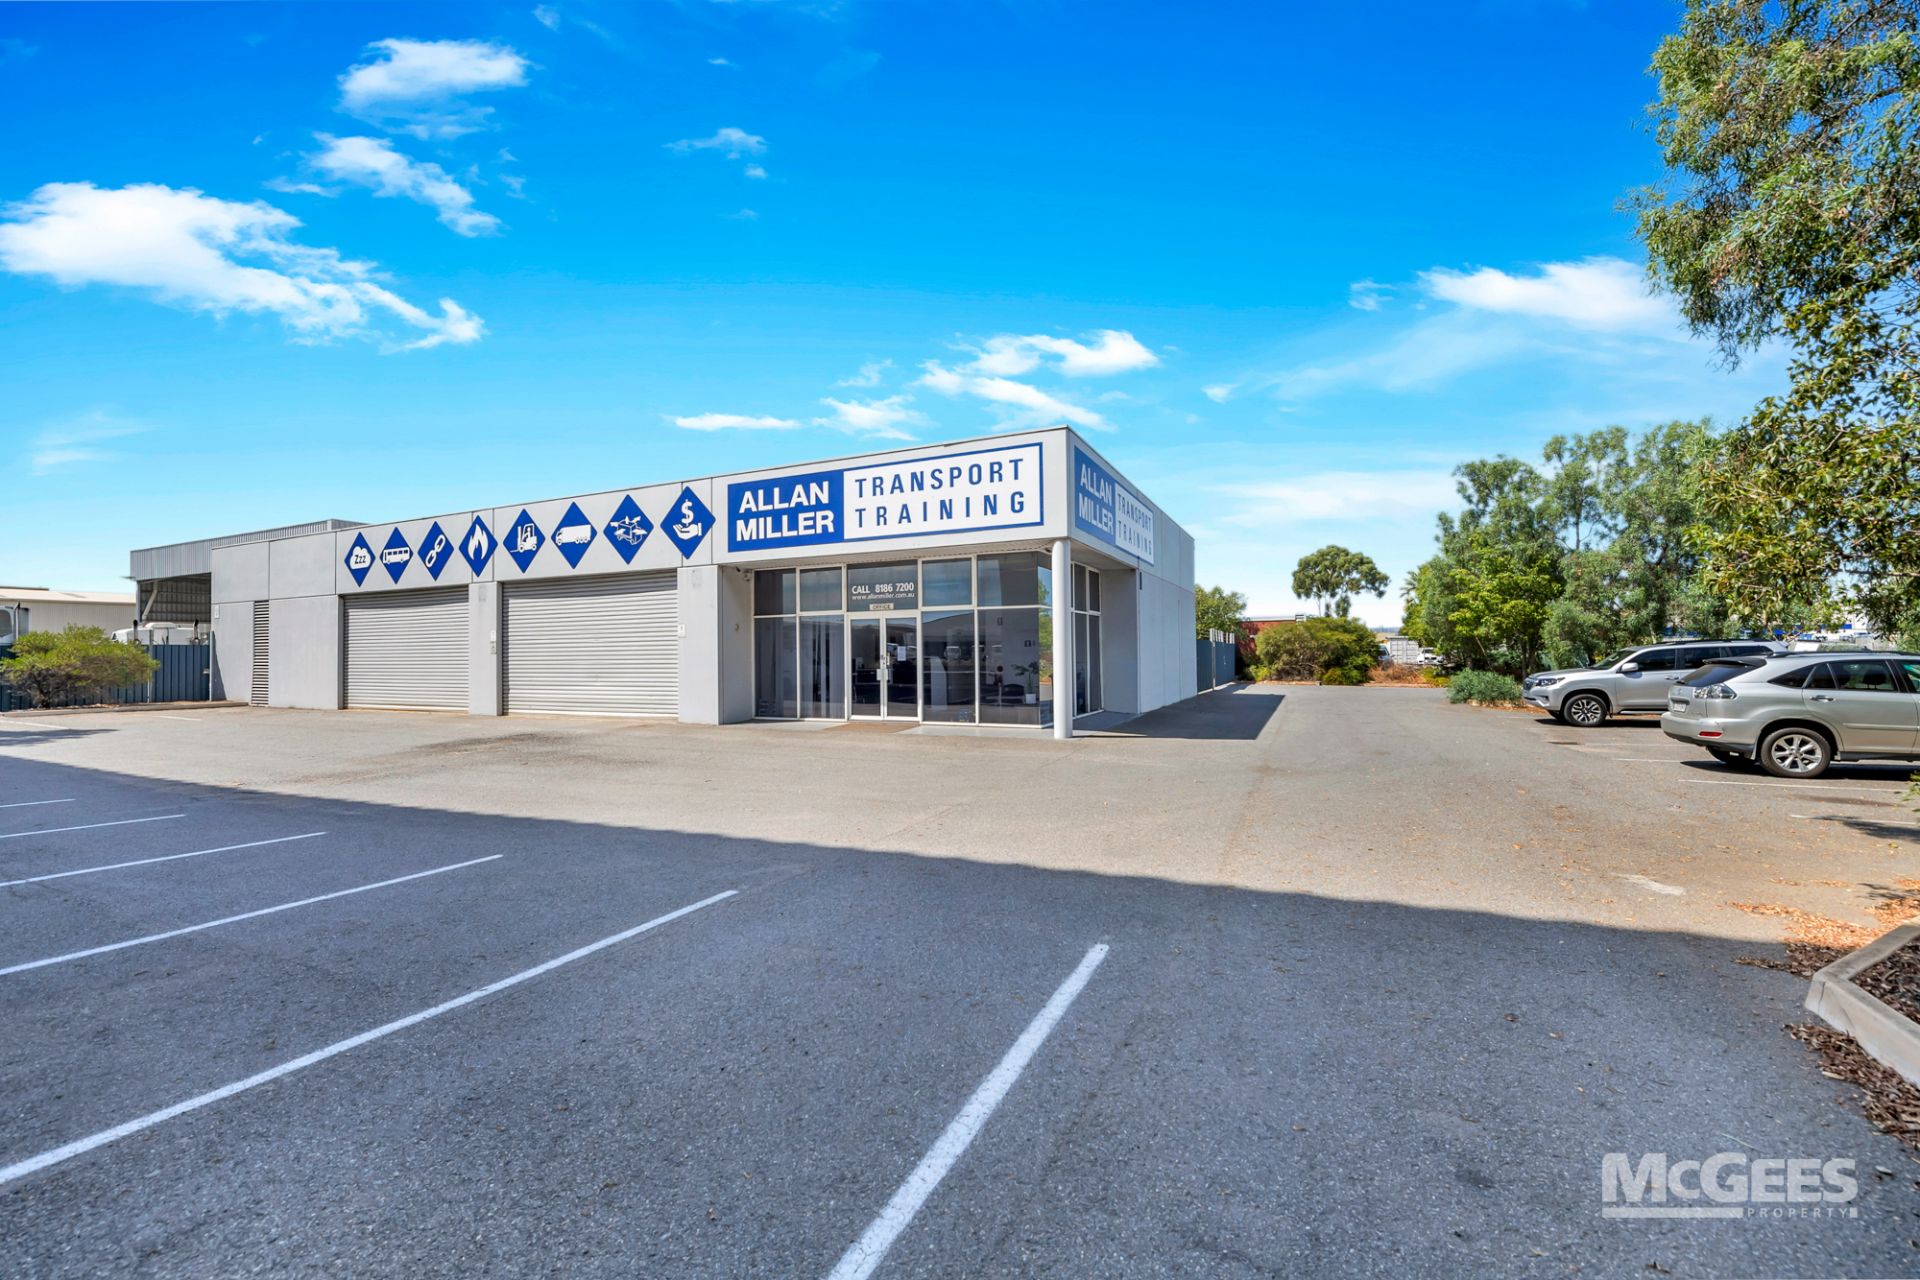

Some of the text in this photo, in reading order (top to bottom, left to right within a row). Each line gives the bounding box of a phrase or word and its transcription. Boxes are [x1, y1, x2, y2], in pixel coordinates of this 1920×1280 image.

[855, 458, 1024, 498] TRANSPORT
[1080, 463, 1112, 507] ALLAN
[739, 481, 830, 514] ALLAN
[855, 491, 1025, 528] TRAINING
[1079, 492, 1114, 536] MILLER
[1118, 493, 1152, 533] TRANSPORT
[736, 510, 835, 541] MILLER
[1118, 520, 1152, 556] TRAINING
[851, 582, 914, 594] CALL 8186 7200
